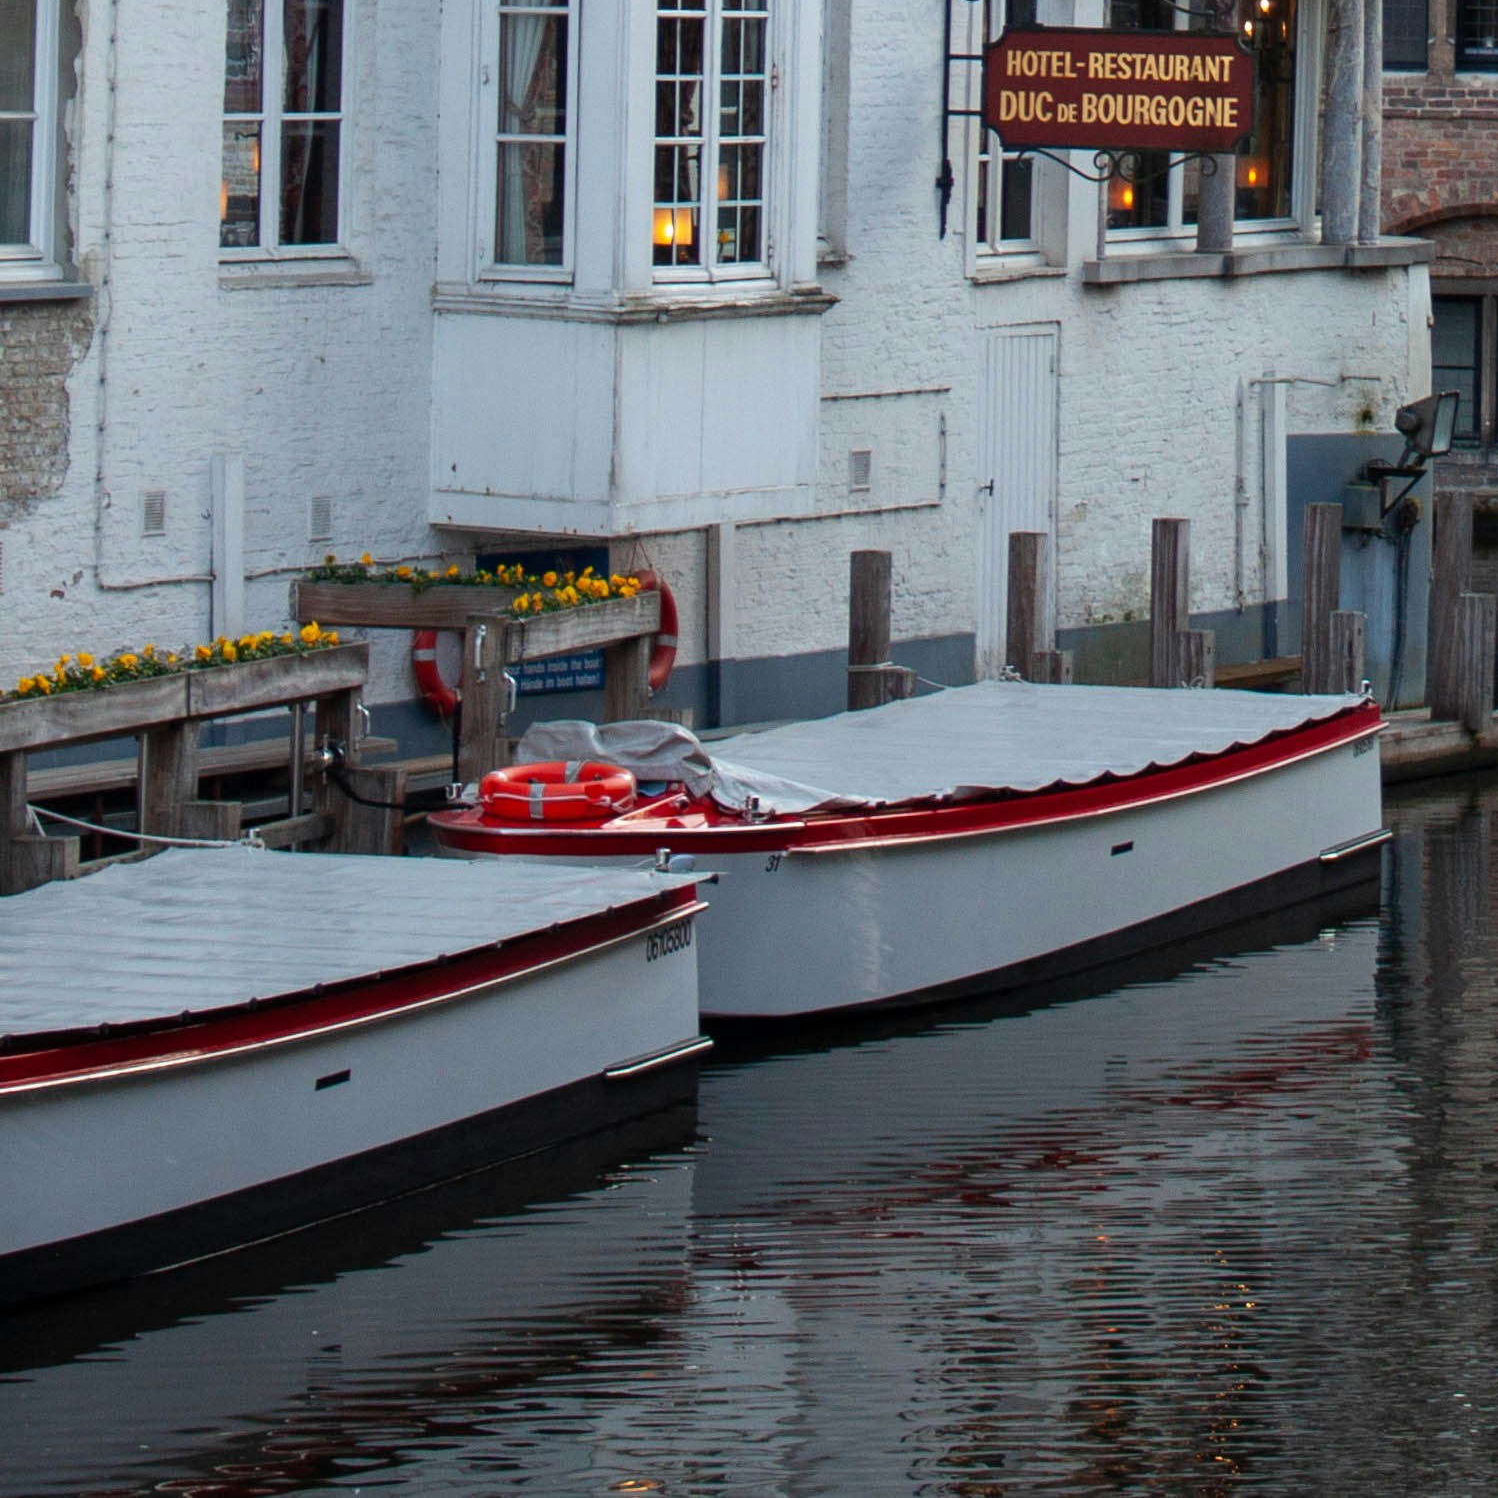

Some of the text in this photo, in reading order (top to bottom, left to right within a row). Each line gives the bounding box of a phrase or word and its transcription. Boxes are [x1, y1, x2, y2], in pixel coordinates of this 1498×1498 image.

[1006, 49, 1235, 83] HOTEL-RESTAURANT
[999, 90, 1240, 128] DUC DE BOURGOGNE
[766, 854, 781, 873] 31
[646, 918, 692, 963] 06105800
